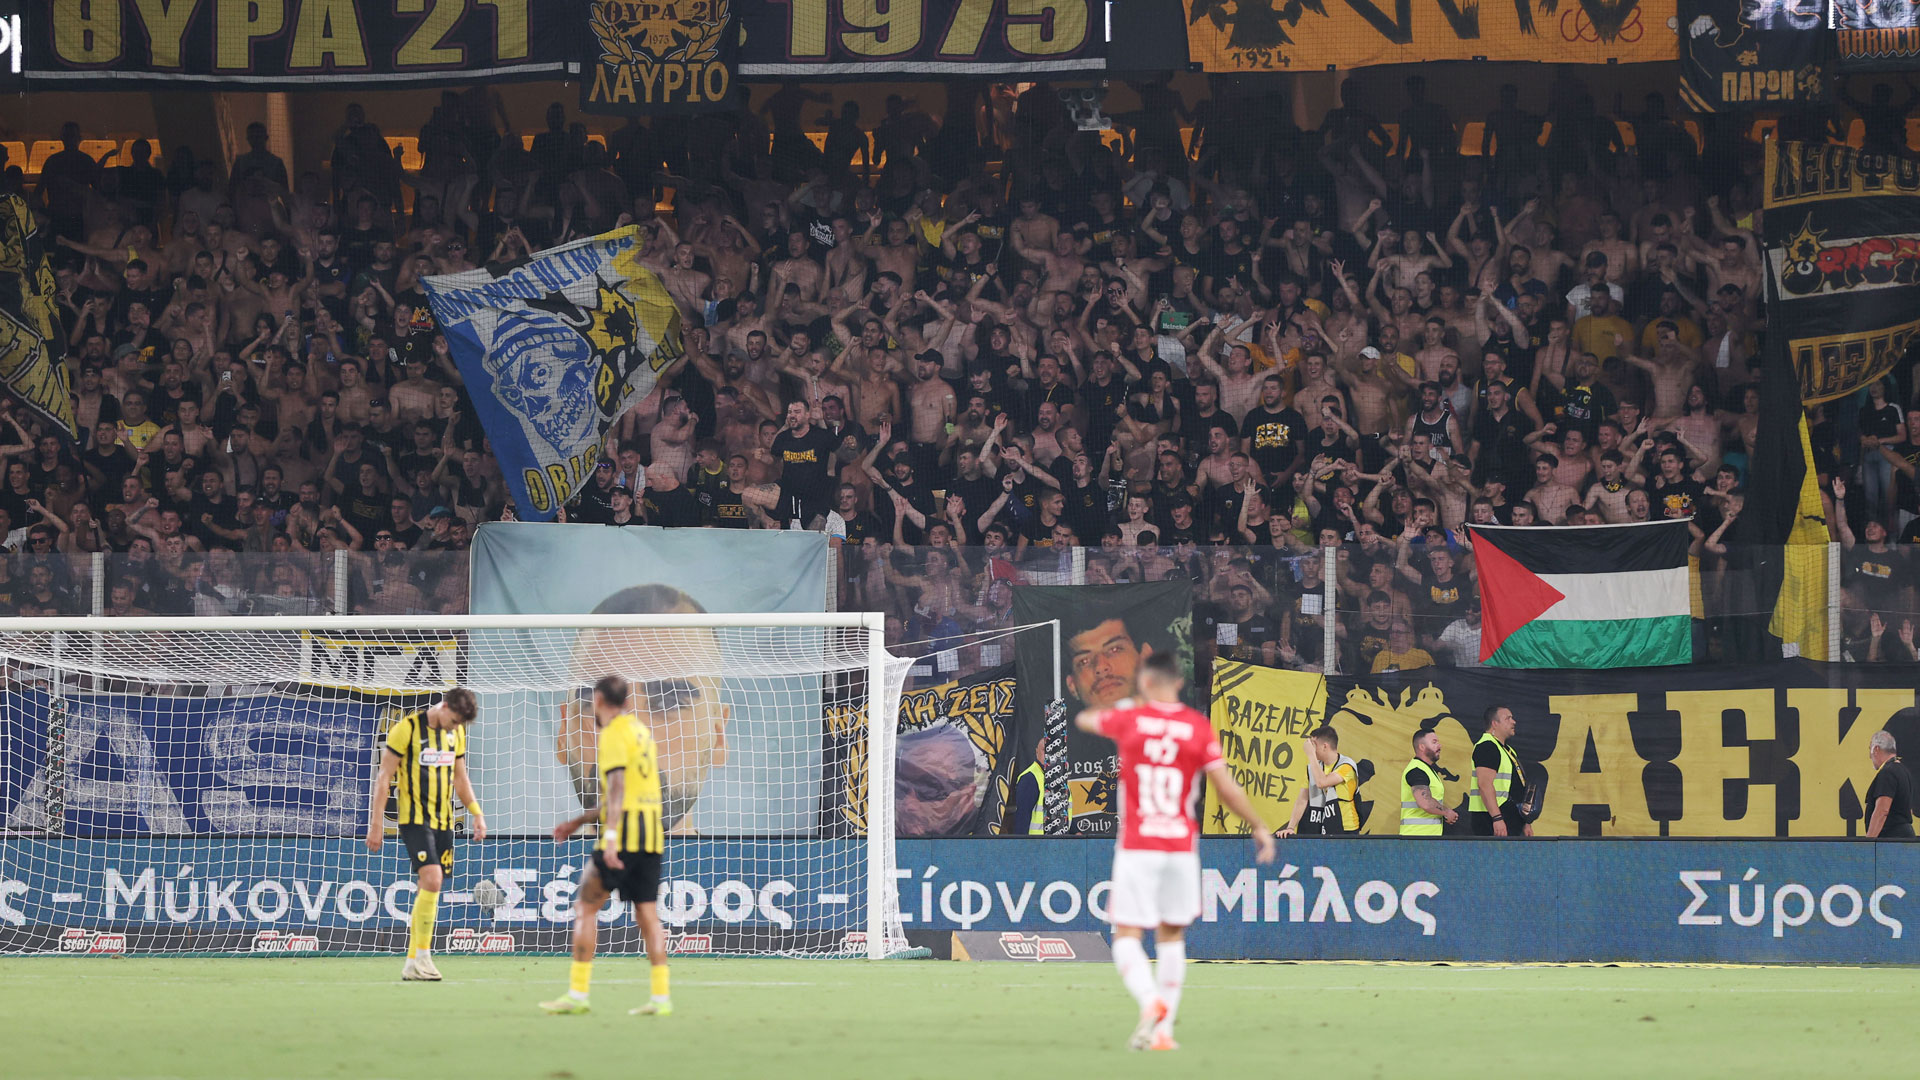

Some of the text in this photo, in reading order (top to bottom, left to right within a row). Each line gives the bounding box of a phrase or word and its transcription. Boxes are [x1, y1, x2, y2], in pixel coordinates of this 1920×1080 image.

[52, 0, 368, 69] ΘΥΡΑ
[396, 0, 528, 65] 21
[782, 0, 1089, 56] 1975
[589, 61, 729, 103] ΛΑΥΡΙΟ
[1231, 51, 1292, 69] 1924
[524, 445, 598, 512] ORIG
[1226, 695, 1321, 739] ΒΑΖΕΛΕΣ
[1220, 728, 1294, 769] ΠΑΛΙΟ
[1532, 688, 1920, 838] ΑΕΚ
[1076, 818, 1112, 833] Only
[494, 865, 797, 930] Σέφος
[1202, 864, 1441, 936] Μήλος
[1677, 866, 1907, 939] Σύρος
